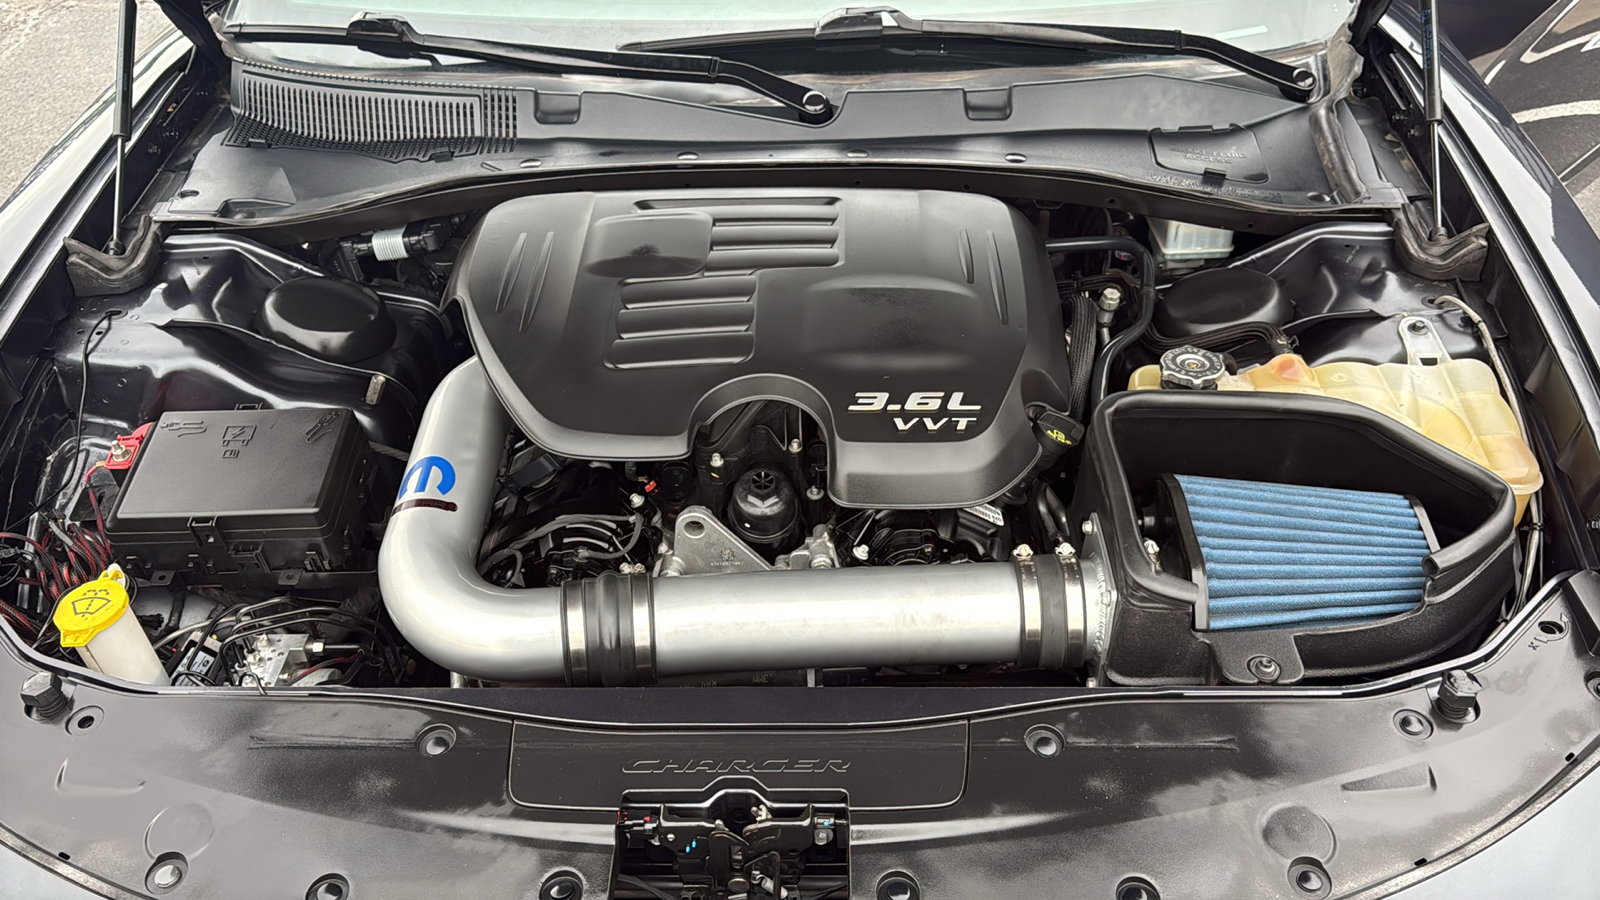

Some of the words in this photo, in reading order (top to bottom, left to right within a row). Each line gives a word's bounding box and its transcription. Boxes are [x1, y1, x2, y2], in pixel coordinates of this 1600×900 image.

[847, 391, 982, 411] 3.6L
[893, 417, 978, 431] VVT
[622, 758, 851, 774] CHARGER
